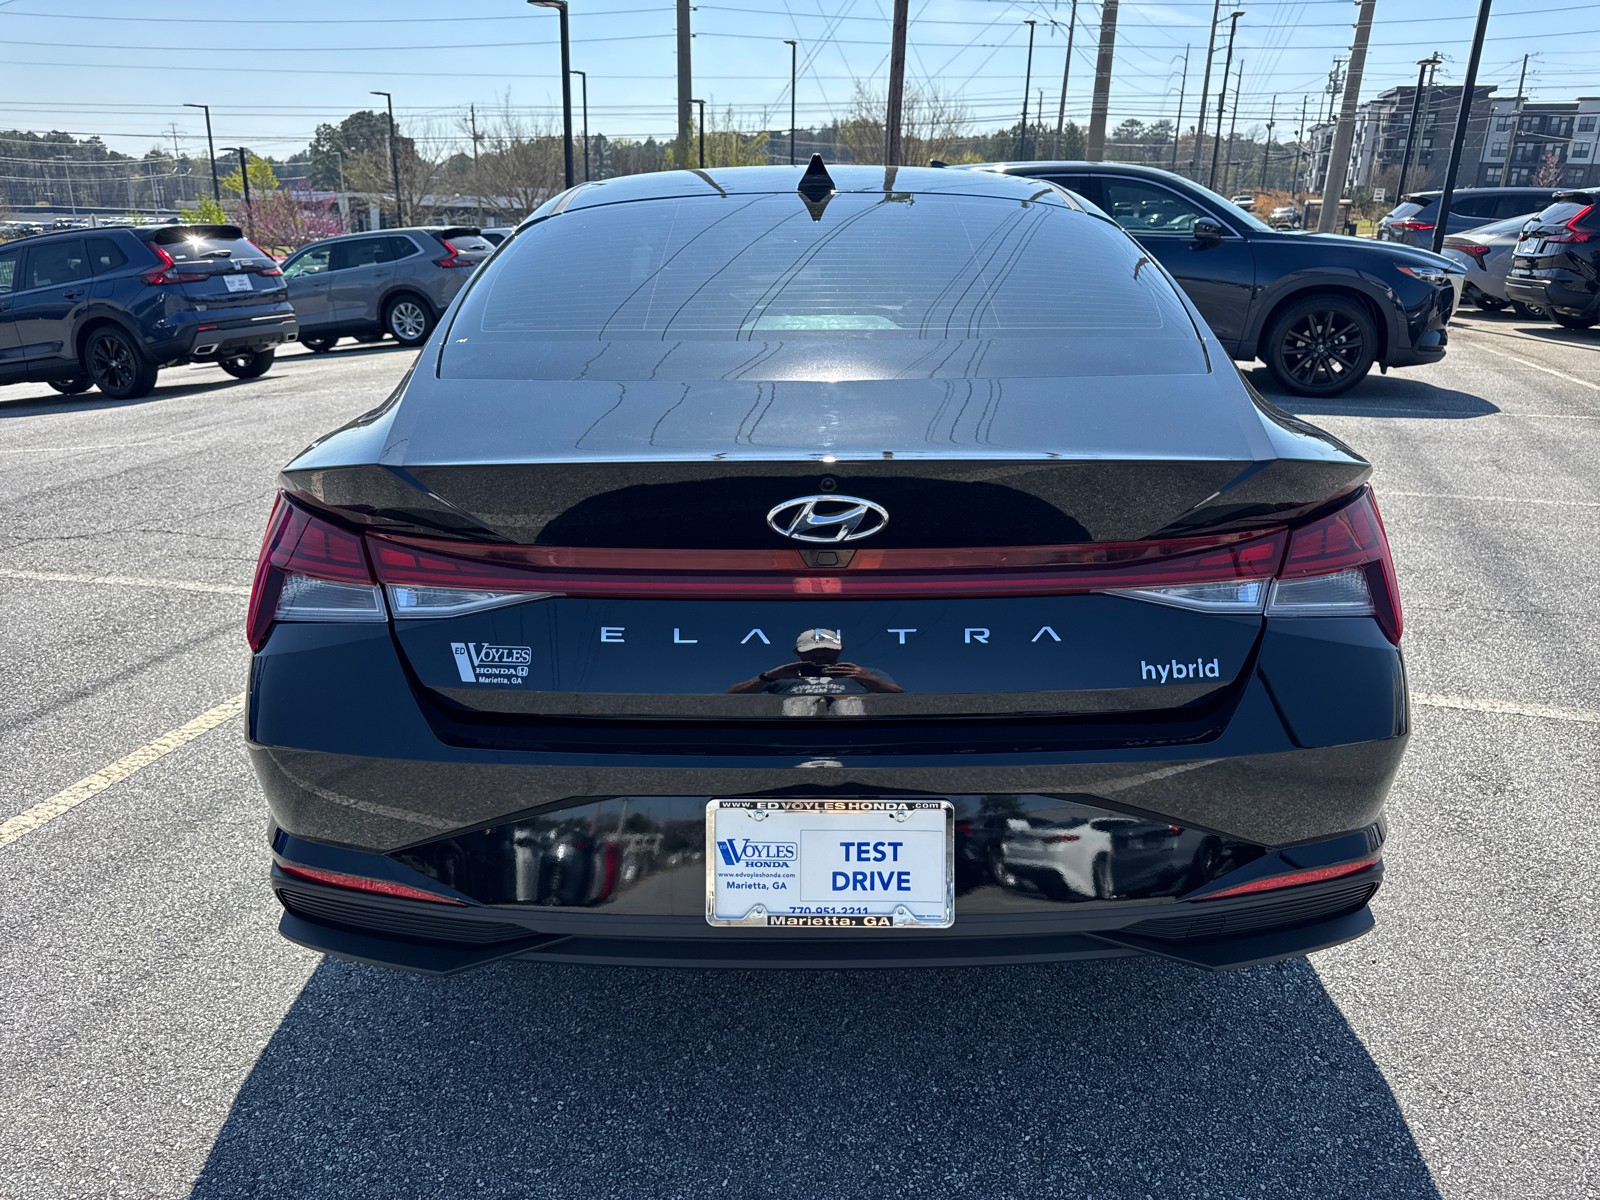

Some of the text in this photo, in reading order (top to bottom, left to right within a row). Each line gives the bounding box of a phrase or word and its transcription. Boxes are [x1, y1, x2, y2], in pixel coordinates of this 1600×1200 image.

[600, 626, 1062, 644] ELANTRA
[467, 642, 530, 667] VOYLES
[475, 667, 517, 675] HONDA
[1140, 657, 1219, 684] hybrid
[478, 676, 510, 685] Marietta,
[726, 838, 794, 864] VOYLES
[839, 842, 904, 862] TEST
[726, 881, 787, 890] Marietta, GA
[831, 871, 912, 892] DRIVE
[770, 916, 891, 926] Marietta, GA
